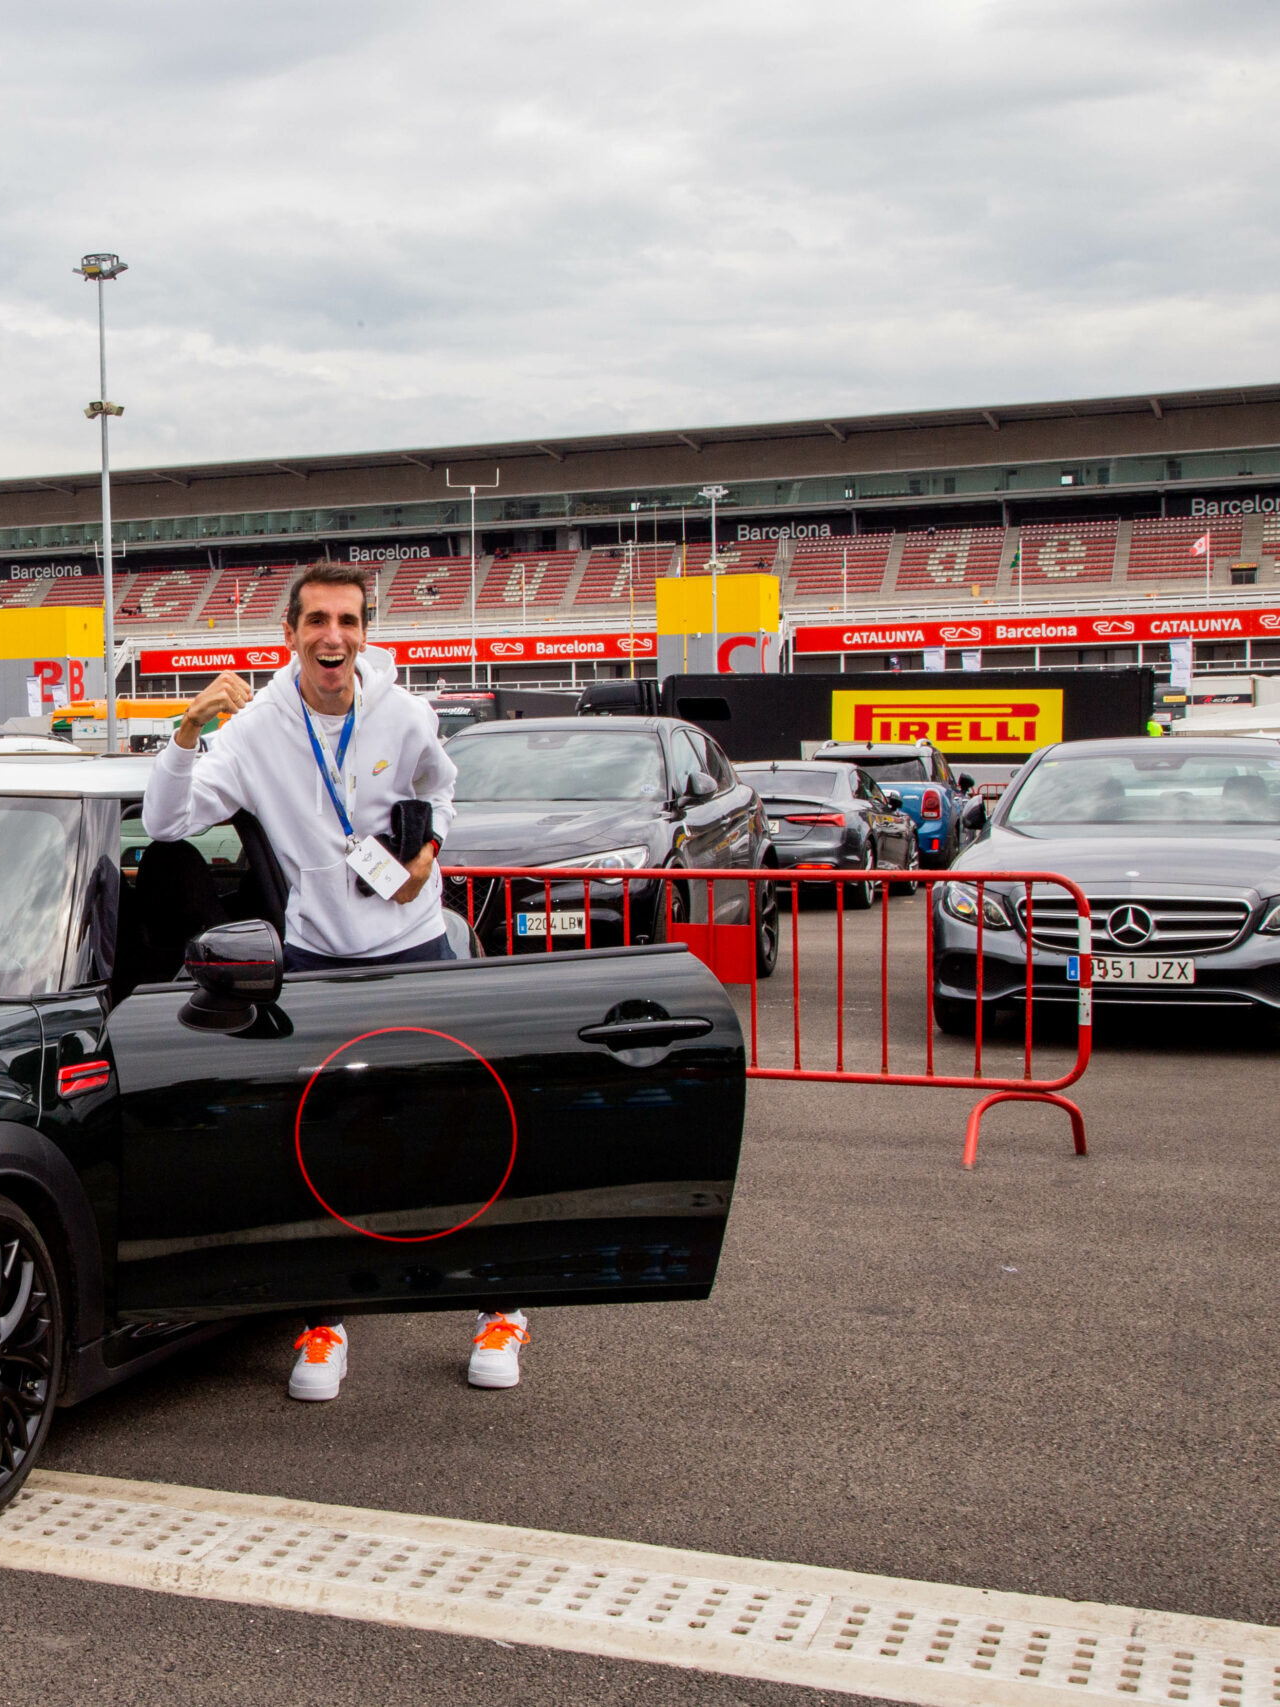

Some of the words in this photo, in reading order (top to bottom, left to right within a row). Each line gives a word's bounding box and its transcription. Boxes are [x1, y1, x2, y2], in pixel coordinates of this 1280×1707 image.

[737, 521, 831, 541] Barcelona
[349, 544, 430, 562] Barcelona
[10, 563, 82, 580] Barcelona
[843, 629, 925, 645] CATALUNYA
[996, 623, 1077, 639] Barcelona
[1150, 617, 1242, 634] CATALUNYA
[408, 644, 478, 659] CATALUNYA
[536, 640, 605, 655] Barcelona
[171, 653, 235, 667] CATALUNYA
[69, 660, 85, 701] B
[854, 703, 1040, 742] PIRELLI
[1147, 961, 1190, 980] JZX
